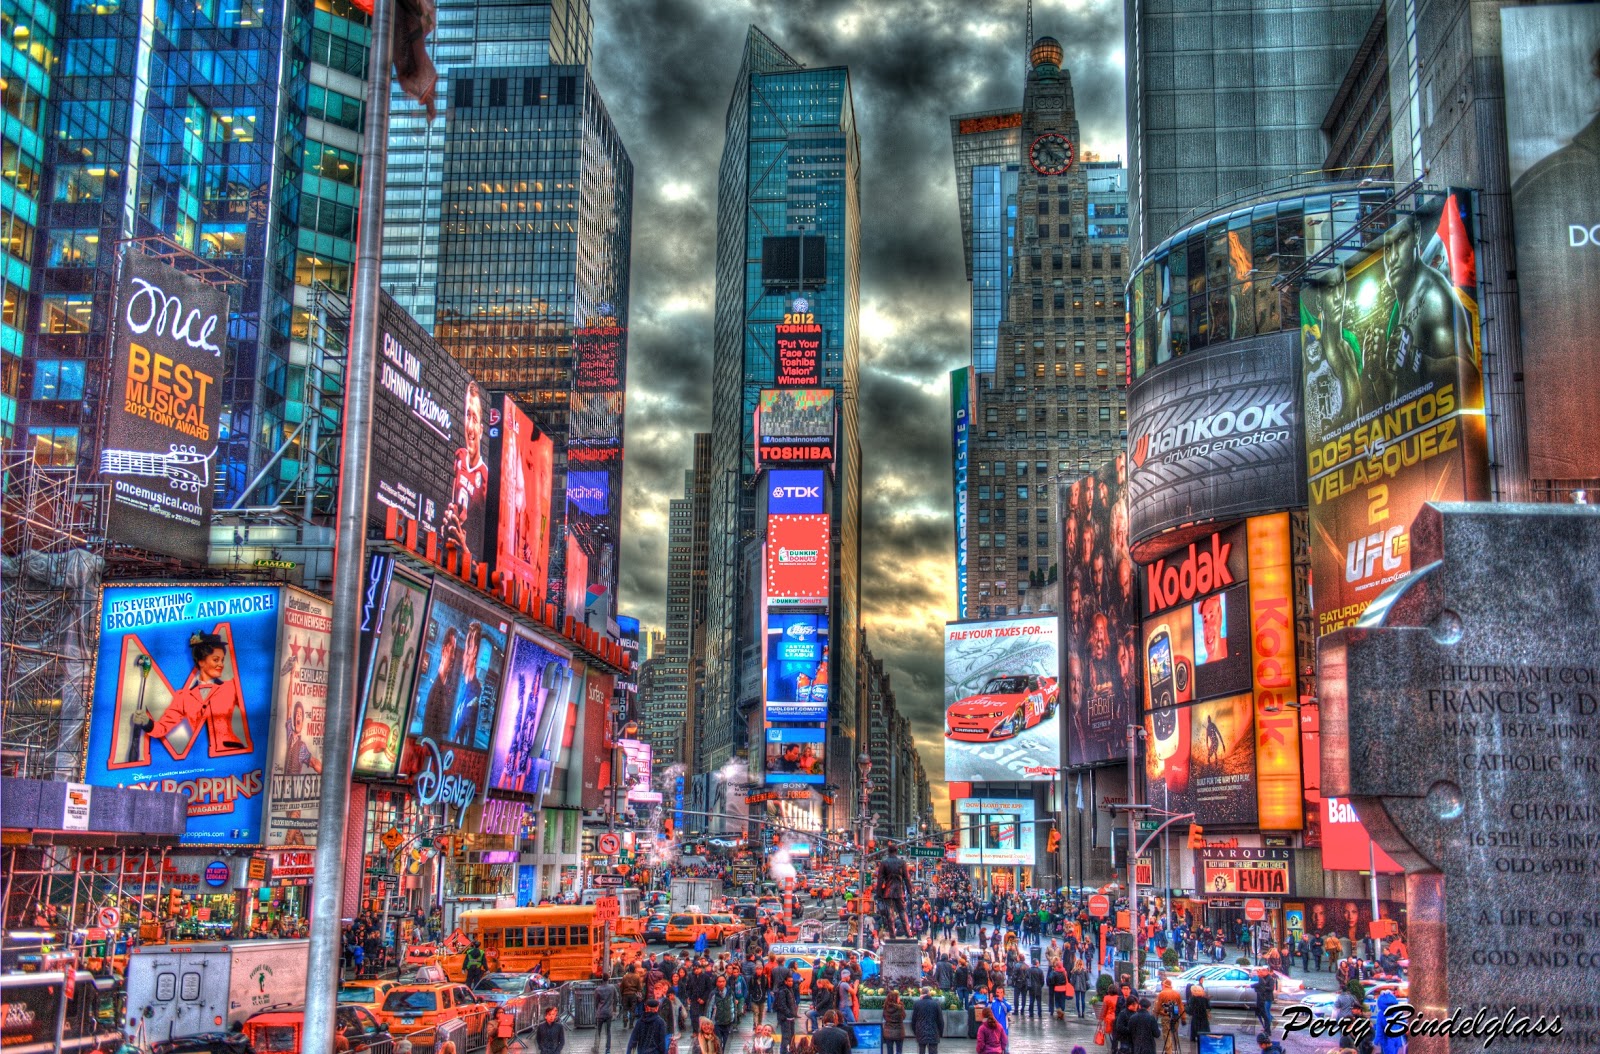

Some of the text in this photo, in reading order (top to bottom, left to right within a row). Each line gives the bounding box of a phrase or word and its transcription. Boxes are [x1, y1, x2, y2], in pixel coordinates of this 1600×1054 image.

[776, 325, 821, 333] TOSHIBA
[784, 314, 814, 324] 2012
[780, 349, 802, 357] Face
[799, 340, 819, 348] Your
[384, 333, 420, 382] CALL HIM
[781, 358, 815, 366] Toshiba
[127, 342, 214, 408] BEST
[381, 363, 413, 406] JOHNNY
[778, 376, 817, 385] Winners!
[125, 381, 209, 431] MUSICAL
[1321, 381, 1434, 443] WORLD HEAVYWEIGHT CHAMPIONSHIP
[124, 400, 210, 441] 2012 TONY AWARD
[1308, 383, 1455, 476] DOS SANTOS
[760, 447, 832, 459] TOSHIBA
[957, 409, 967, 483] LISTED
[1163, 429, 1290, 466] driving emotion
[1363, 436, 1387, 460] VS
[1310, 418, 1458, 506] VELASQUEZ
[116, 481, 203, 515] oncemusical.com
[783, 487, 819, 497] TDK
[1367, 483, 1391, 526] 2
[959, 490, 968, 567] NASDAQ
[256, 559, 295, 569] LAMAR
[1345, 524, 1410, 583] UFC 15
[1148, 532, 1234, 613] Kodak
[111, 592, 193, 614] IT'S EVERYTHING
[197, 601, 228, 619] AND
[229, 594, 275, 615] MORE!
[1319, 599, 1373, 626] SATURDAY
[950, 631, 967, 640] FILE
[968, 629, 993, 639] YOUR
[994, 627, 1021, 638] TAXES
[1254, 597, 1293, 747] Kodak
[1441, 665, 1552, 683] LIEUTENANT
[293, 683, 307, 696] JOLT
[588, 683, 604, 704] Surface
[1033, 694, 1045, 715] 88
[1427, 690, 1540, 715] FRANCIS
[1577, 693, 1598, 716] D
[307, 723, 325, 736] MUSI
[1443, 722, 1478, 737] MAY
[1485, 723, 1495, 737] 2
[1463, 754, 1598, 773] CATHOLIC PR
[162, 769, 263, 804] POPPINS
[188, 804, 230, 814] AVAGANZA!
[480, 799, 526, 834] FOREVER
[1328, 798, 1360, 824] Ban
[1510, 803, 1600, 820] CHAPLAIN
[1469, 831, 1520, 847] 165TH
[915, 849, 940, 857] Broadway
[1203, 849, 1289, 858] MARQUIS
[70, 857, 178, 872] IGITAL
[1496, 858, 1535, 873] OLD
[1238, 870, 1285, 892] EVITA
[1501, 911, 1540, 926] LIFE
[1548, 911, 1572, 927] OF
[1553, 933, 1585, 946] FOR
[1472, 951, 1519, 966] GOD
[1526, 952, 1568, 967] AND
